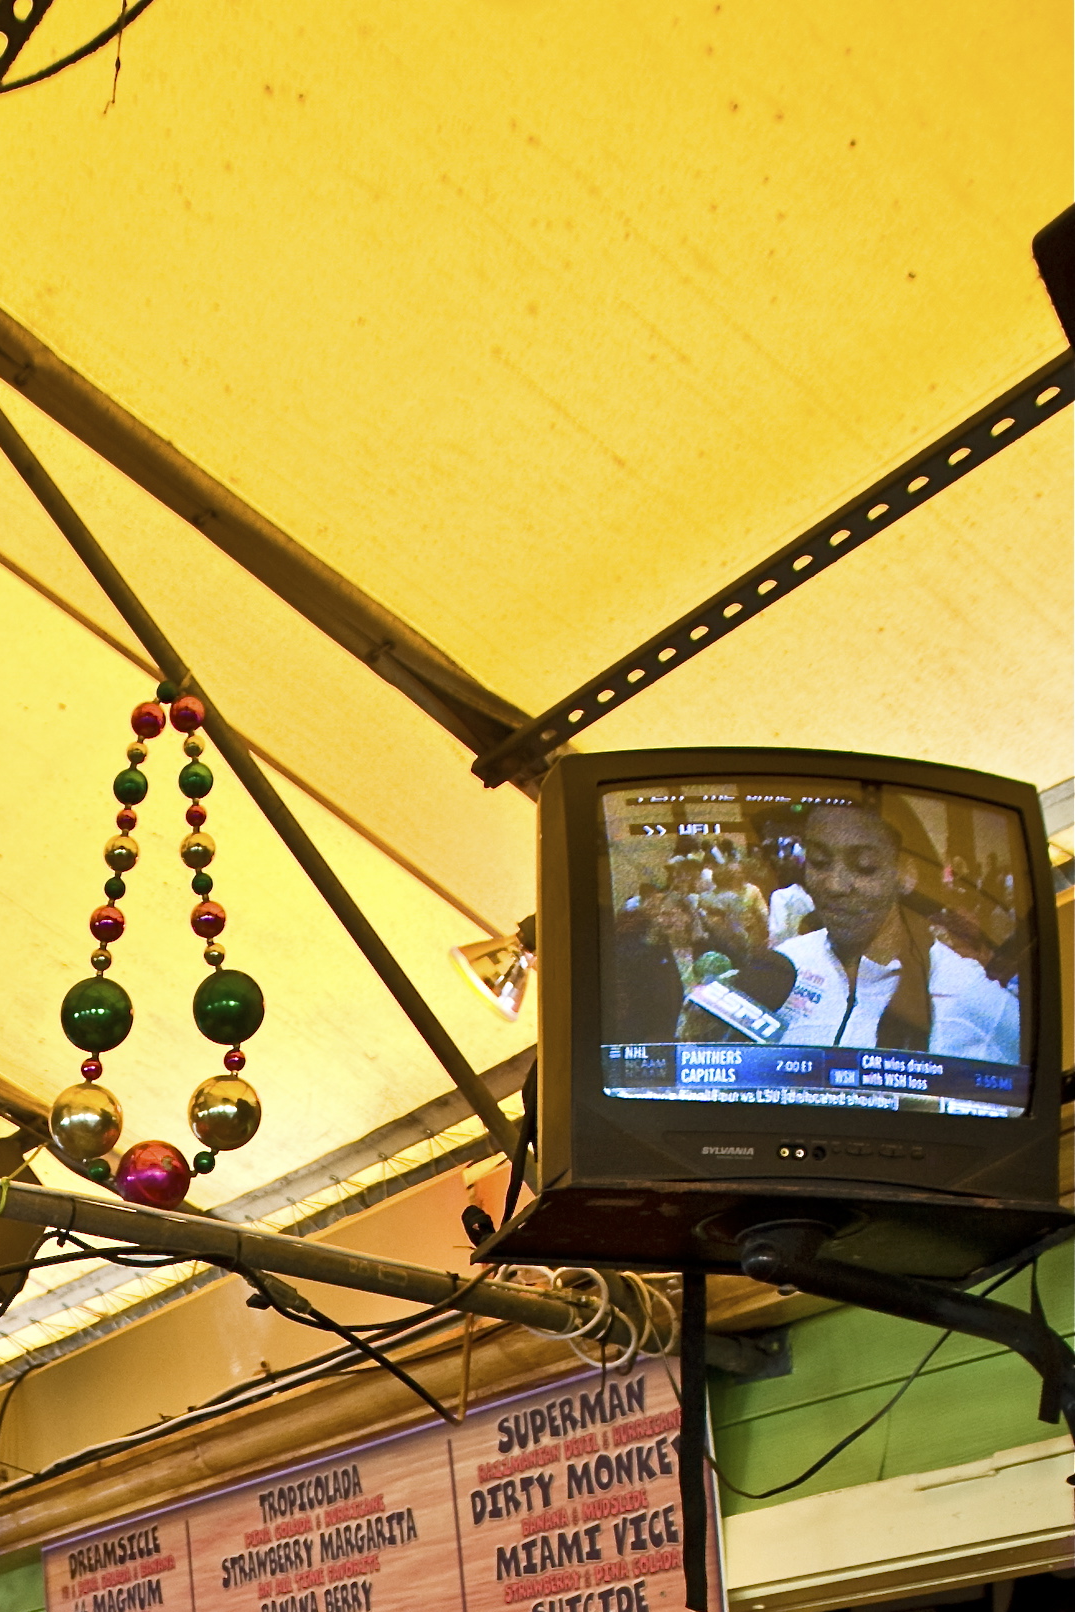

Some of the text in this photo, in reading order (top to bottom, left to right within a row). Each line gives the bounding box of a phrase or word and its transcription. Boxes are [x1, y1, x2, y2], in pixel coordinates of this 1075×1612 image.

[701, 980, 782, 1038] ESPN
[624, 1046, 649, 1059] NHL
[681, 1050, 743, 1066] PANTHERS
[861, 1055, 944, 1076] CAR wins division
[680, 1068, 737, 1083] CAPITALS
[834, 1071, 856, 1085] WSH
[884, 1073, 907, 1088] WSH
[908, 1076, 928, 1091] loss
[756, 1090, 780, 1104] LSU
[701, 1146, 755, 1156] SYLVANIA
[497, 1375, 646, 1455] SUPERMAN
[564, 1433, 600, 1460] DEVIL
[259, 1463, 363, 1524] TROPICOLADA
[470, 1472, 555, 1526] DIRTY
[522, 1508, 568, 1536] BANANA
[583, 1488, 649, 1522] MUDSLIDE
[68, 1525, 161, 1580] DREAMSICLE
[221, 1507, 418, 1589] STRAWBERRY MARGARITA
[496, 1504, 680, 1581] MIAMI VICE
[504, 1571, 581, 1604] STRAWBERRY
[633, 1549, 682, 1578] COLADA
